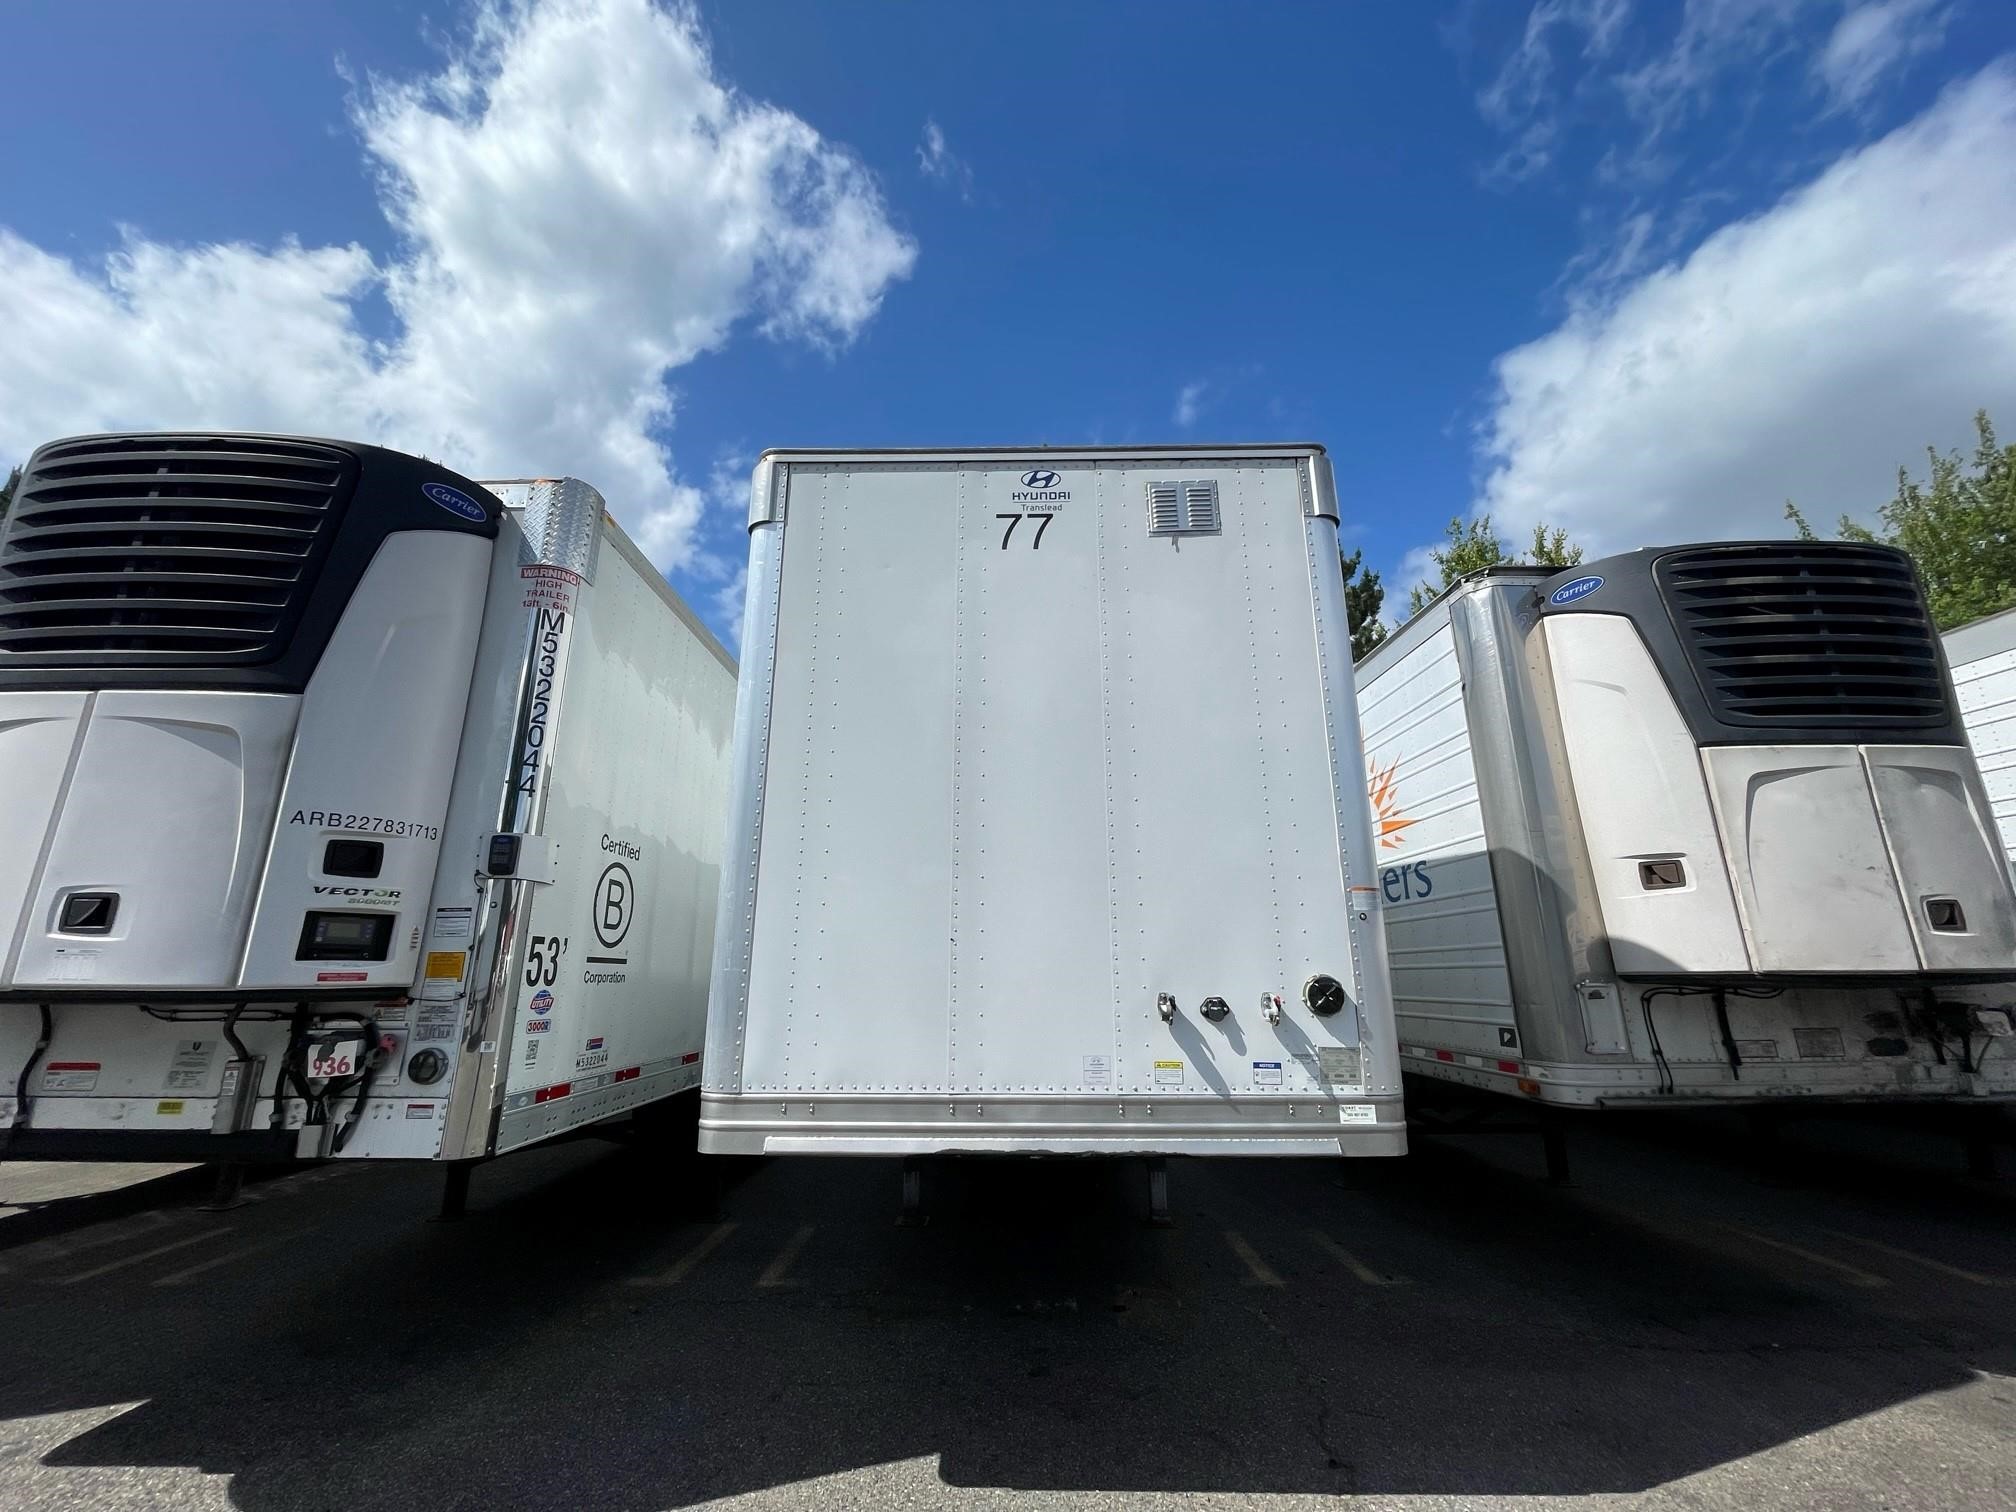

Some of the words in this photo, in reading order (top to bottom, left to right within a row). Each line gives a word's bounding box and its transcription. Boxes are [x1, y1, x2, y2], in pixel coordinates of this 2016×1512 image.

[432, 488, 481, 515] Carrier
[1012, 491, 1071, 500] HYUNDAI
[995, 513, 1054, 550] 77
[523, 568, 577, 584] WARNING
[535, 579, 563, 590] HIGH
[526, 589, 570, 603] TRAILER
[1556, 580, 1596, 601] Carrier
[518, 608, 566, 798] M5322044
[290, 810, 438, 841] ARB227831713
[601, 833, 641, 861] Certified
[313, 886, 402, 898] VECTOR
[1381, 860, 1432, 904] ers
[603, 878, 625, 930] B
[526, 936, 568, 987] 53'
[583, 970, 626, 985] Corporation
[531, 998, 553, 1009] UTILITY
[313, 1055, 351, 1076] 936
